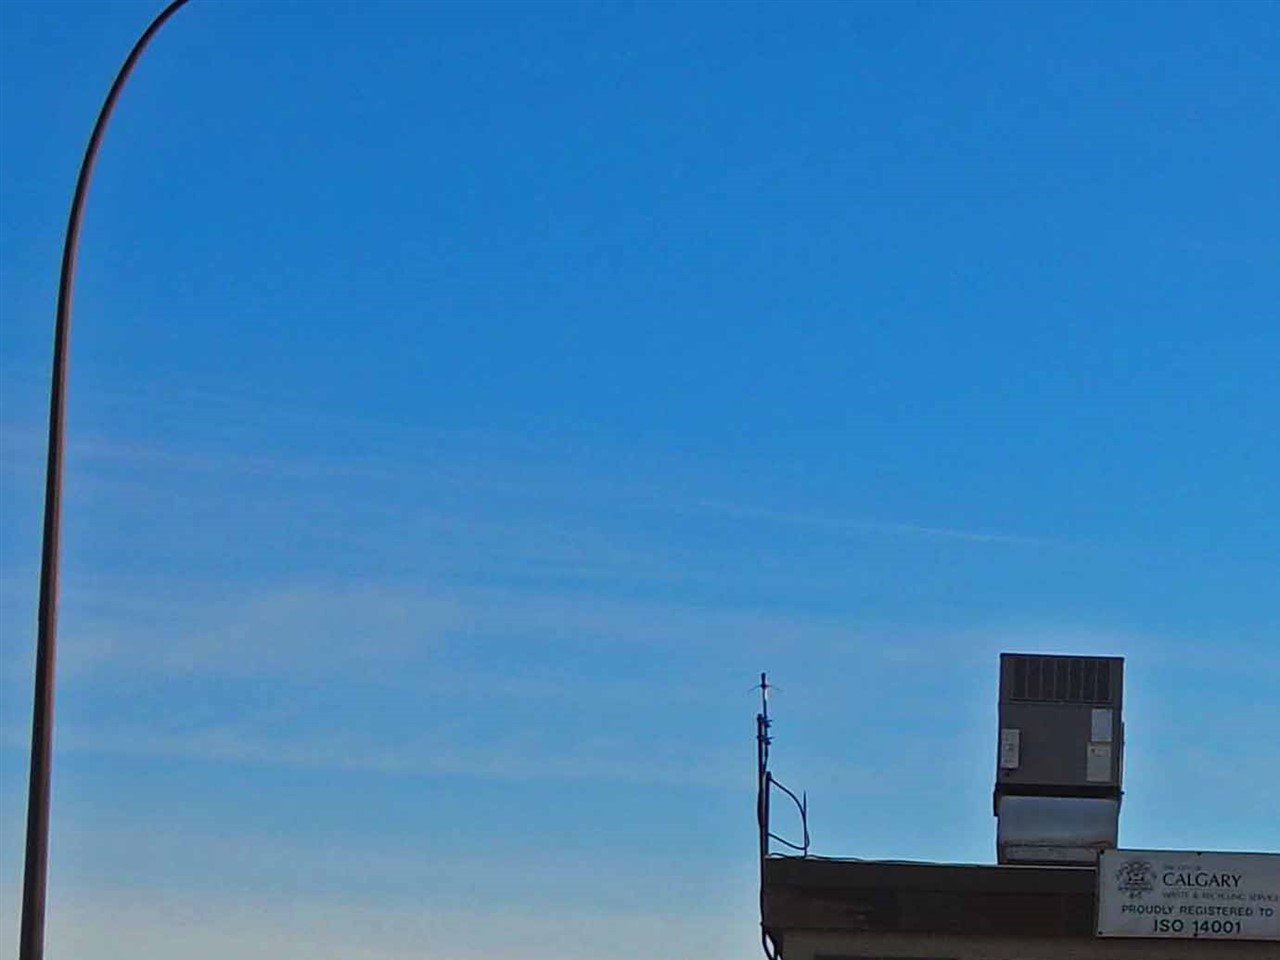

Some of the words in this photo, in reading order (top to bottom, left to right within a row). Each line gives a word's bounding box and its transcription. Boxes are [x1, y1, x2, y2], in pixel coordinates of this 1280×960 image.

[1162, 872, 1242, 888] CALGARY
[1121, 904, 1174, 915] PROUDLY
[1179, 905, 1253, 917] REGISTERED
[1259, 907, 1274, 917] TO
[1153, 919, 1184, 932] ISO
[1192, 920, 1242, 934] 14001
